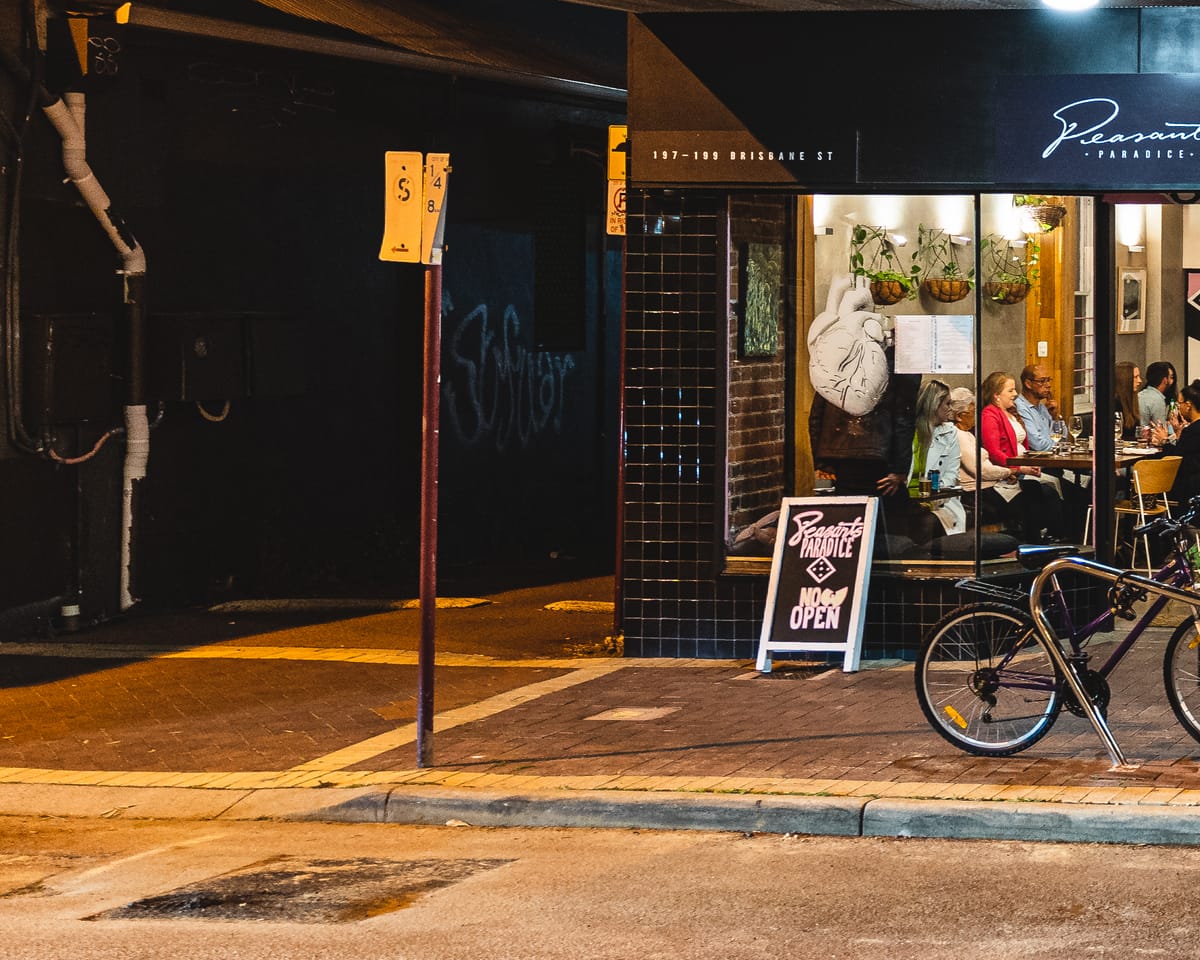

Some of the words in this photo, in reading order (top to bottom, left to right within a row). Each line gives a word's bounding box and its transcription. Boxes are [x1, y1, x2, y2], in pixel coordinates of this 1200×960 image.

[652, 150, 719, 161] 197-199
[730, 151, 805, 161] BRISBANE
[817, 151, 833, 161] ST
[1098, 149, 1185, 159] PARADICE
[788, 510, 864, 547] Peasants
[800, 536, 853, 559] PARADICE
[789, 606, 841, 630] OPEN
